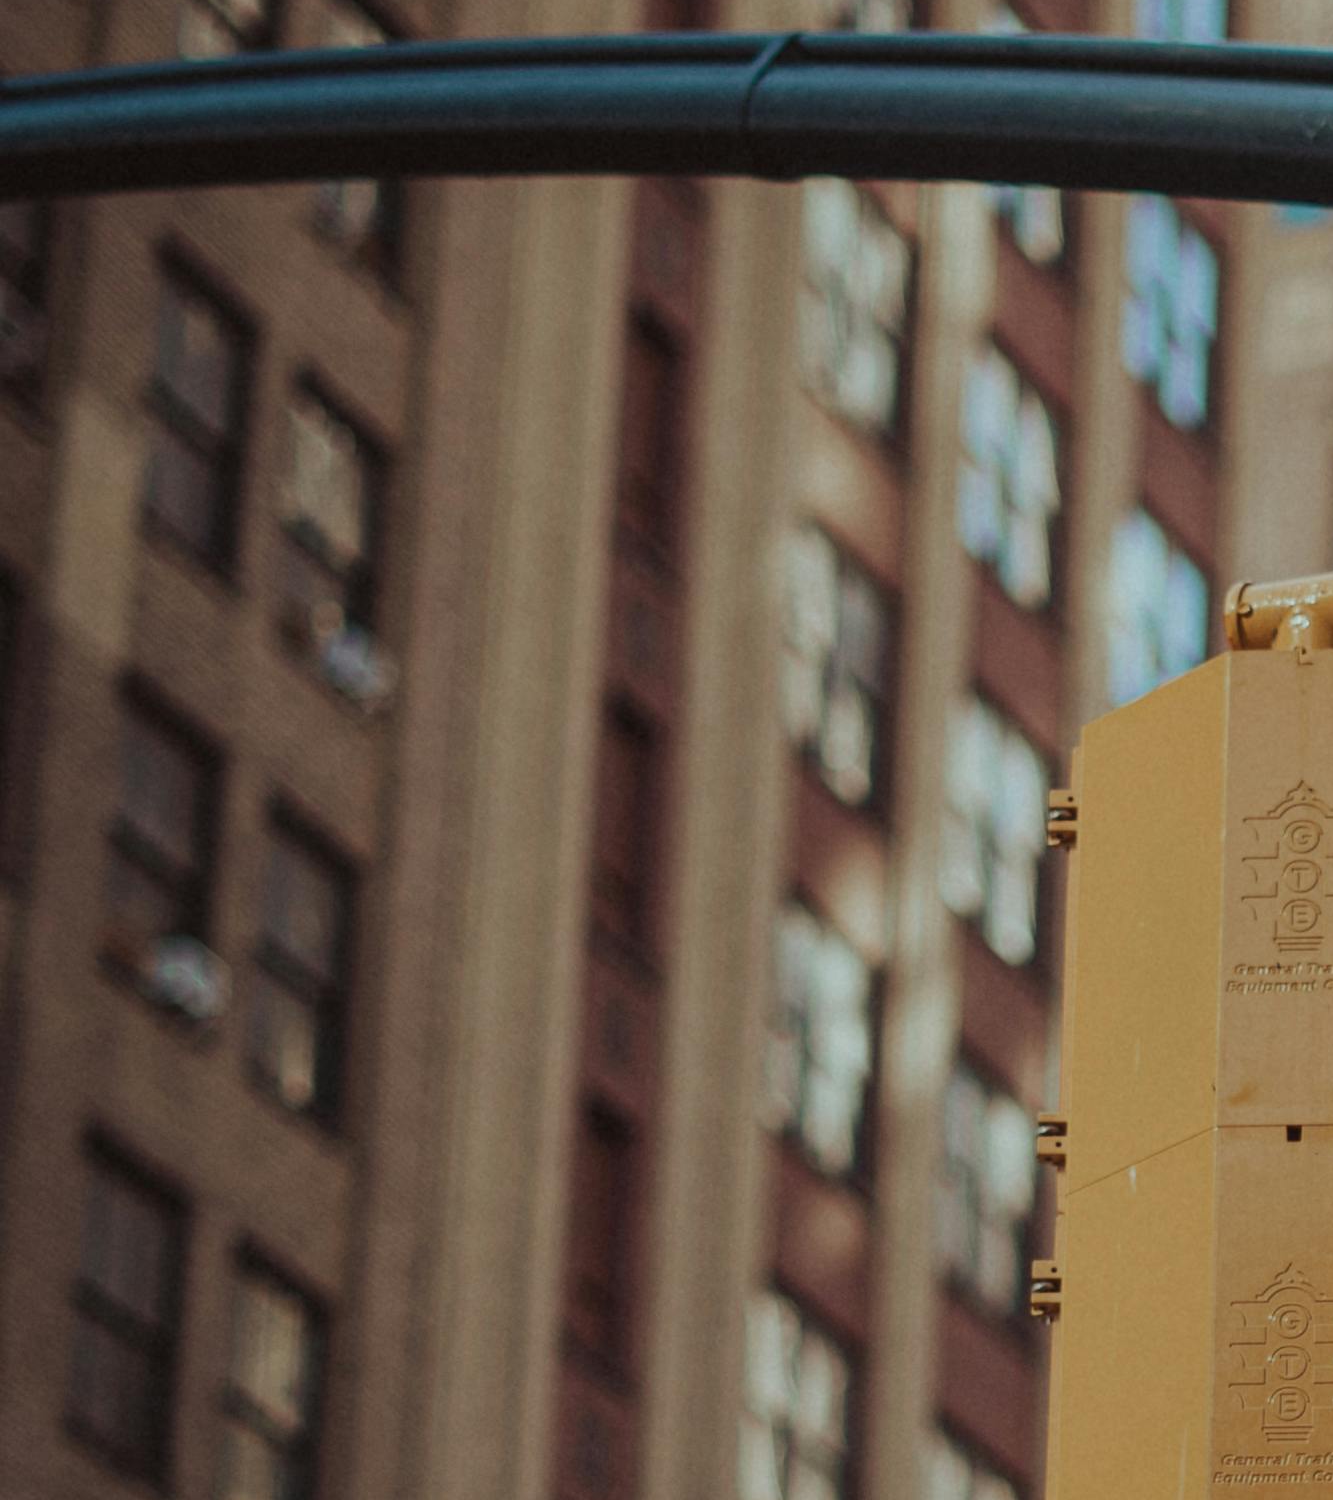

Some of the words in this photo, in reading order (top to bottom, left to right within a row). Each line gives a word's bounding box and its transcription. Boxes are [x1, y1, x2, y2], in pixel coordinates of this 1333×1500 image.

[1234, 962, 1303, 976] General
[1226, 980, 1316, 995] Equipment
[1221, 1453, 1292, 1467] General
[1213, 1470, 1307, 1486] Equipment
